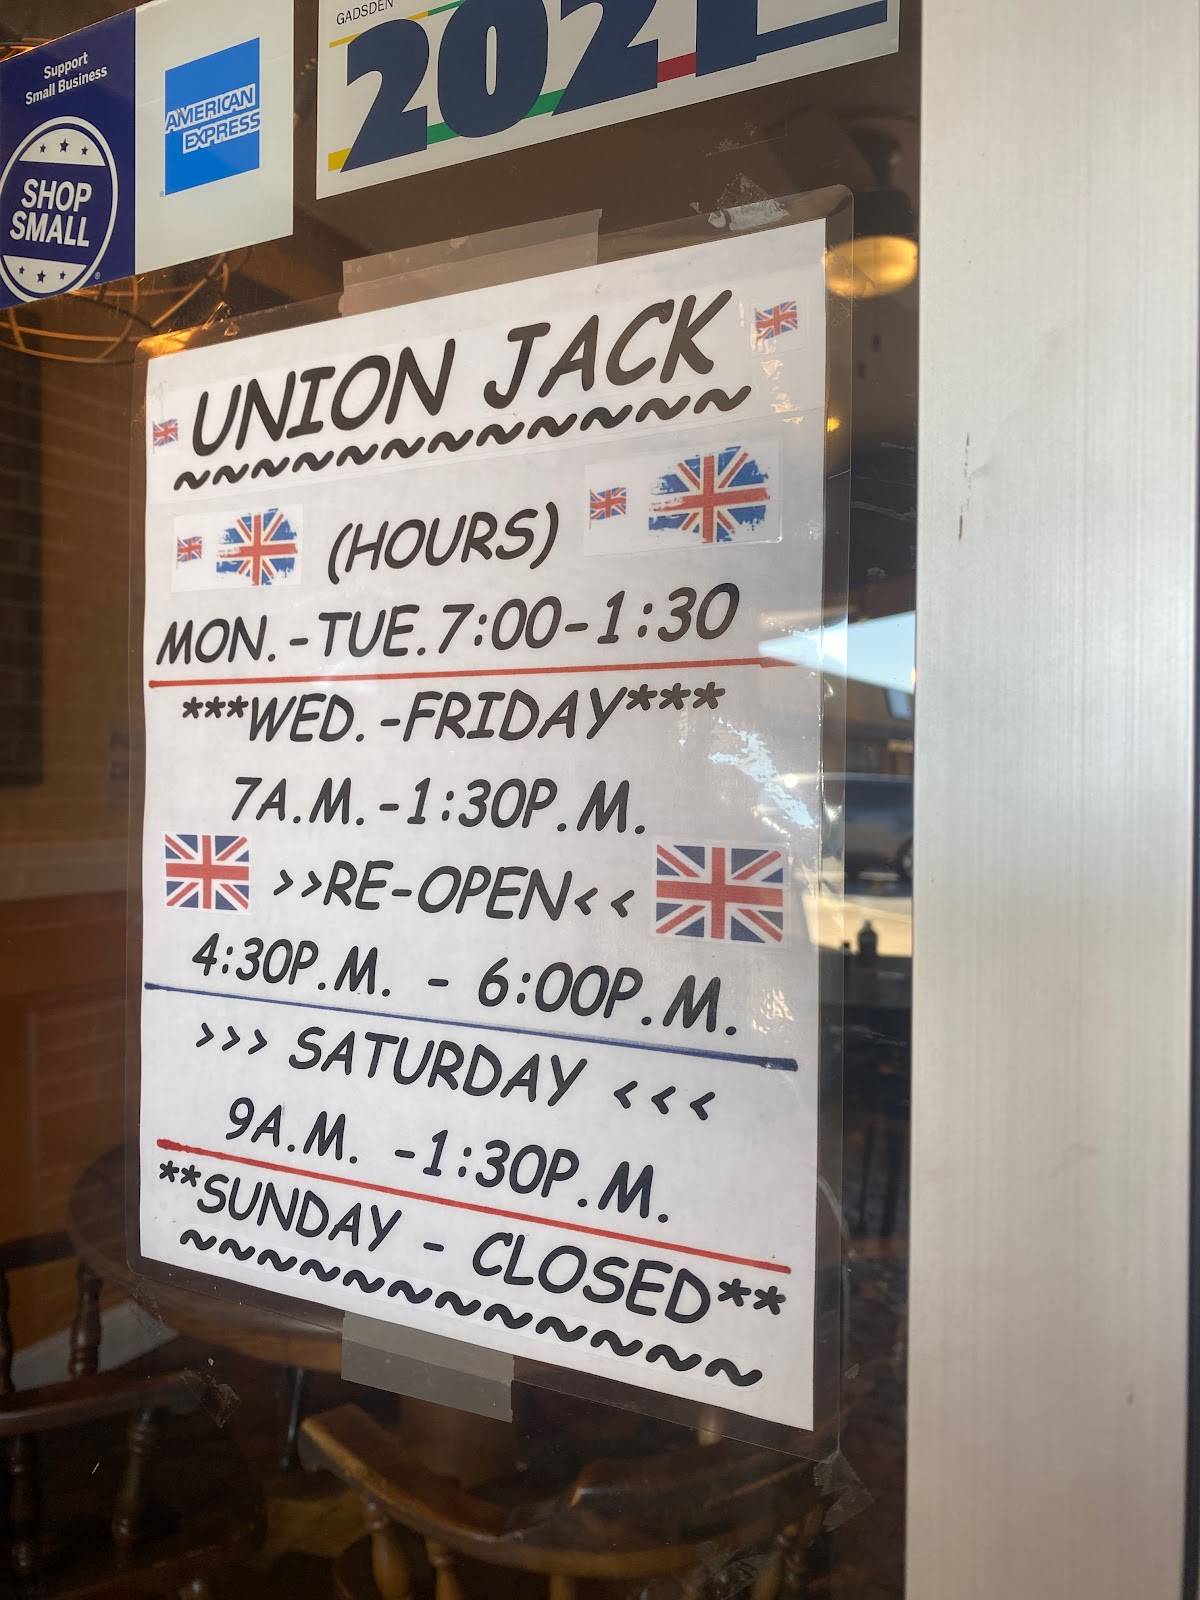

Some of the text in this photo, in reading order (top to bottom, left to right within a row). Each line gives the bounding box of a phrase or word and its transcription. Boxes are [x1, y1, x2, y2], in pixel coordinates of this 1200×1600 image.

[336, 0, 393, 25] GADSDEN
[25, 65, 107, 105] Small Business
[43, 51, 88, 80] Support
[165, 84, 256, 133] AMERICAN
[184, 111, 260, 153] EXPRESS
[21, 178, 93, 213] SHOP
[9, 211, 90, 248] SMALL
[192, 289, 733, 457] UNION JACK
[327, 501, 559, 586] (HOURS)
[288, 1026, 588, 1108] SATURDAY
